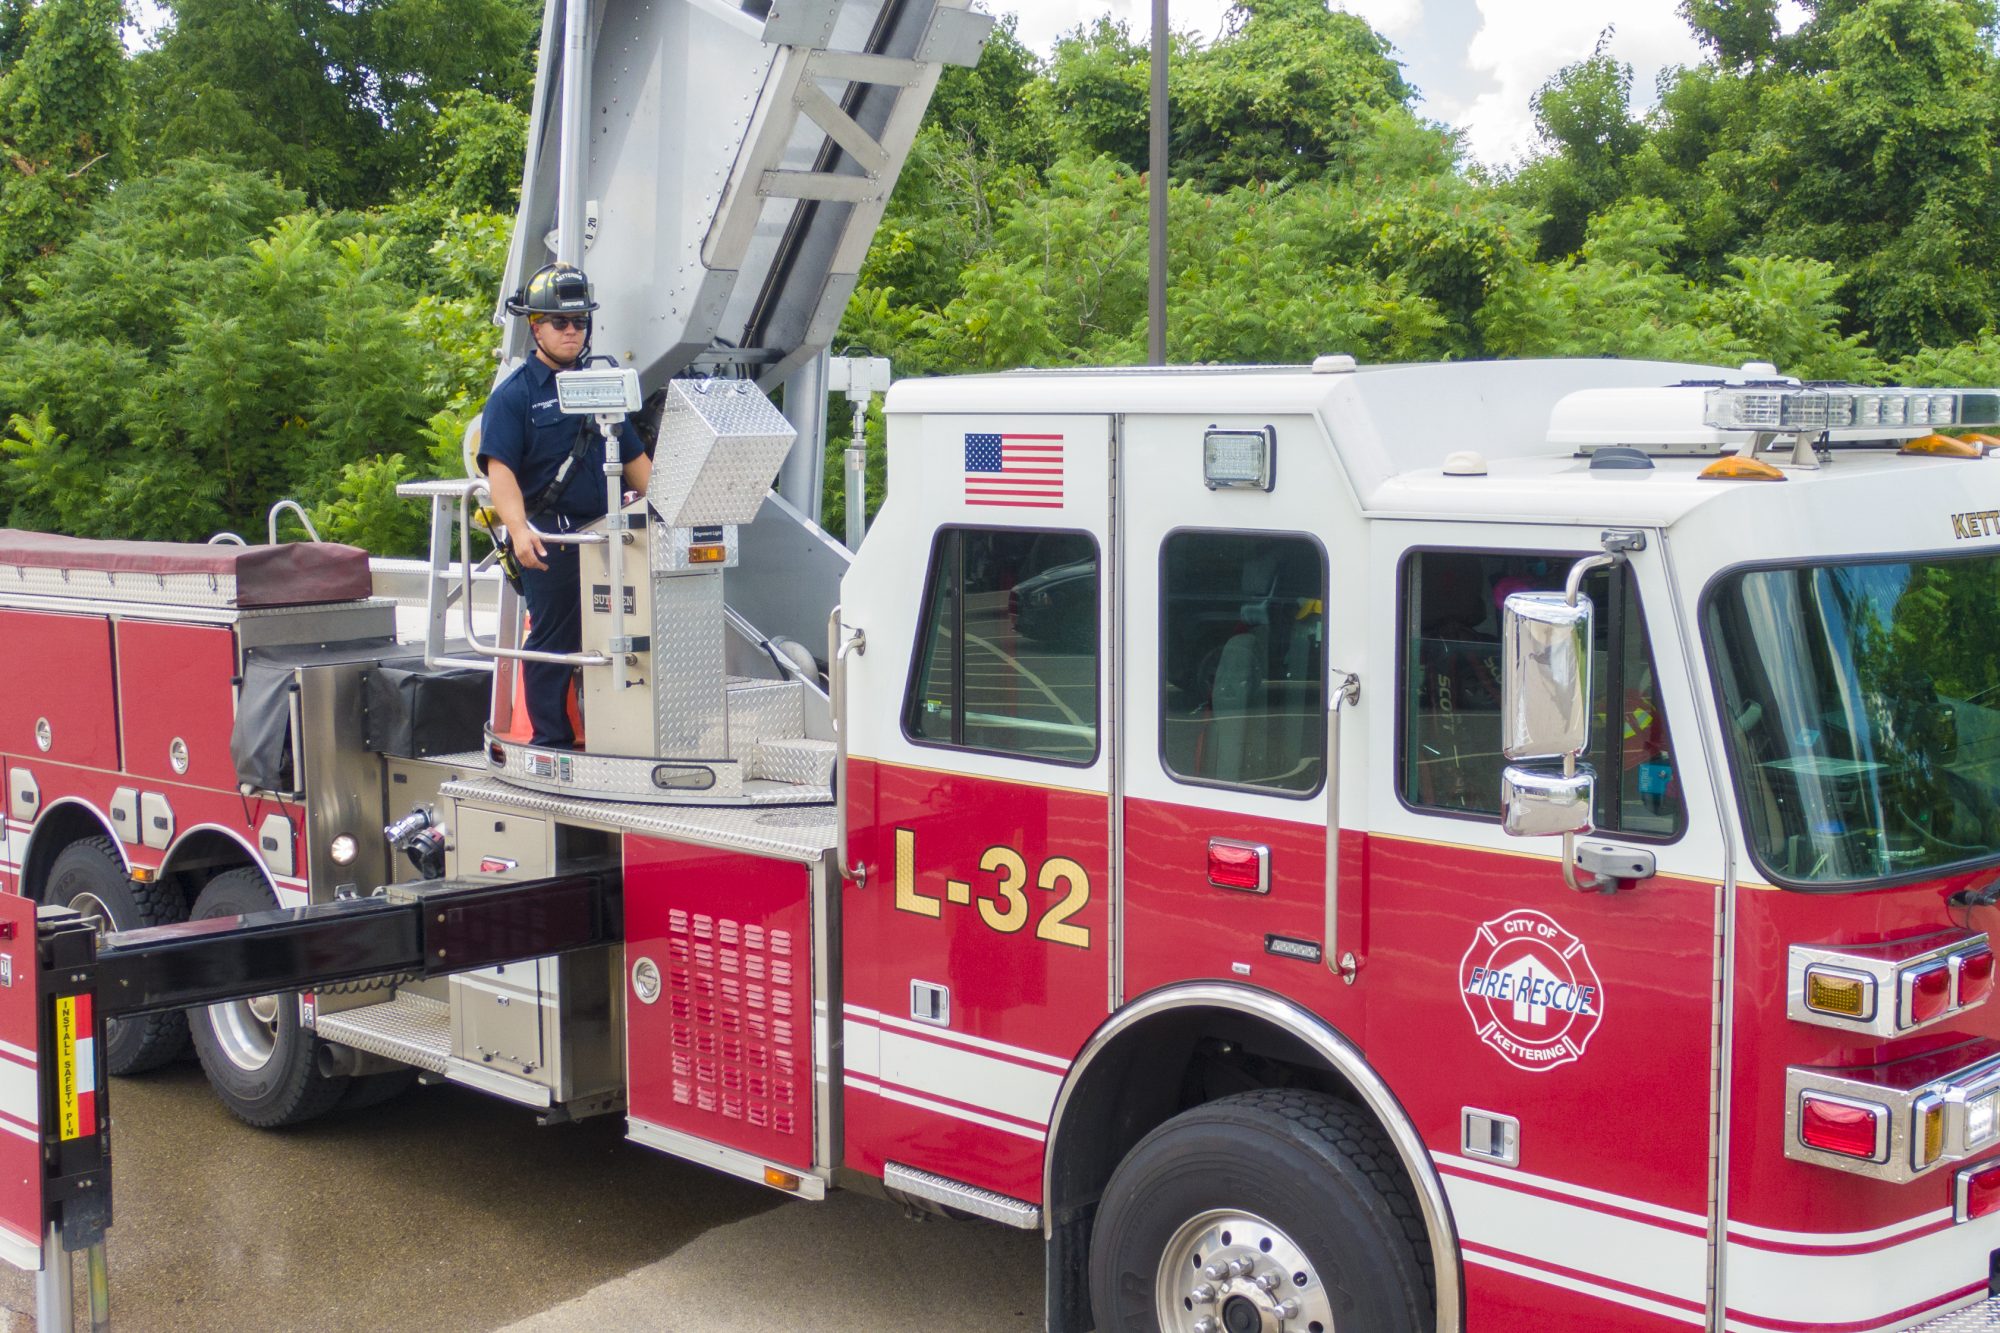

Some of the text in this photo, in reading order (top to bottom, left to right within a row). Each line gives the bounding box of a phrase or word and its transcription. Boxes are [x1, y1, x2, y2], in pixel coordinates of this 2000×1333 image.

[1951, 510, 2000, 539] KETT
[593, 593, 633, 606] SUTEN
[1438, 673, 1455, 735] SCOTT
[894, 827, 1091, 950] L-32
[1503, 919, 1558, 939] CITY OF
[1468, 967, 1595, 1014] FIRE RESCUE
[1493, 1030, 1567, 1061] KETTERING
[62, 1000, 74, 1137] INSTALL SAFETY PIN
